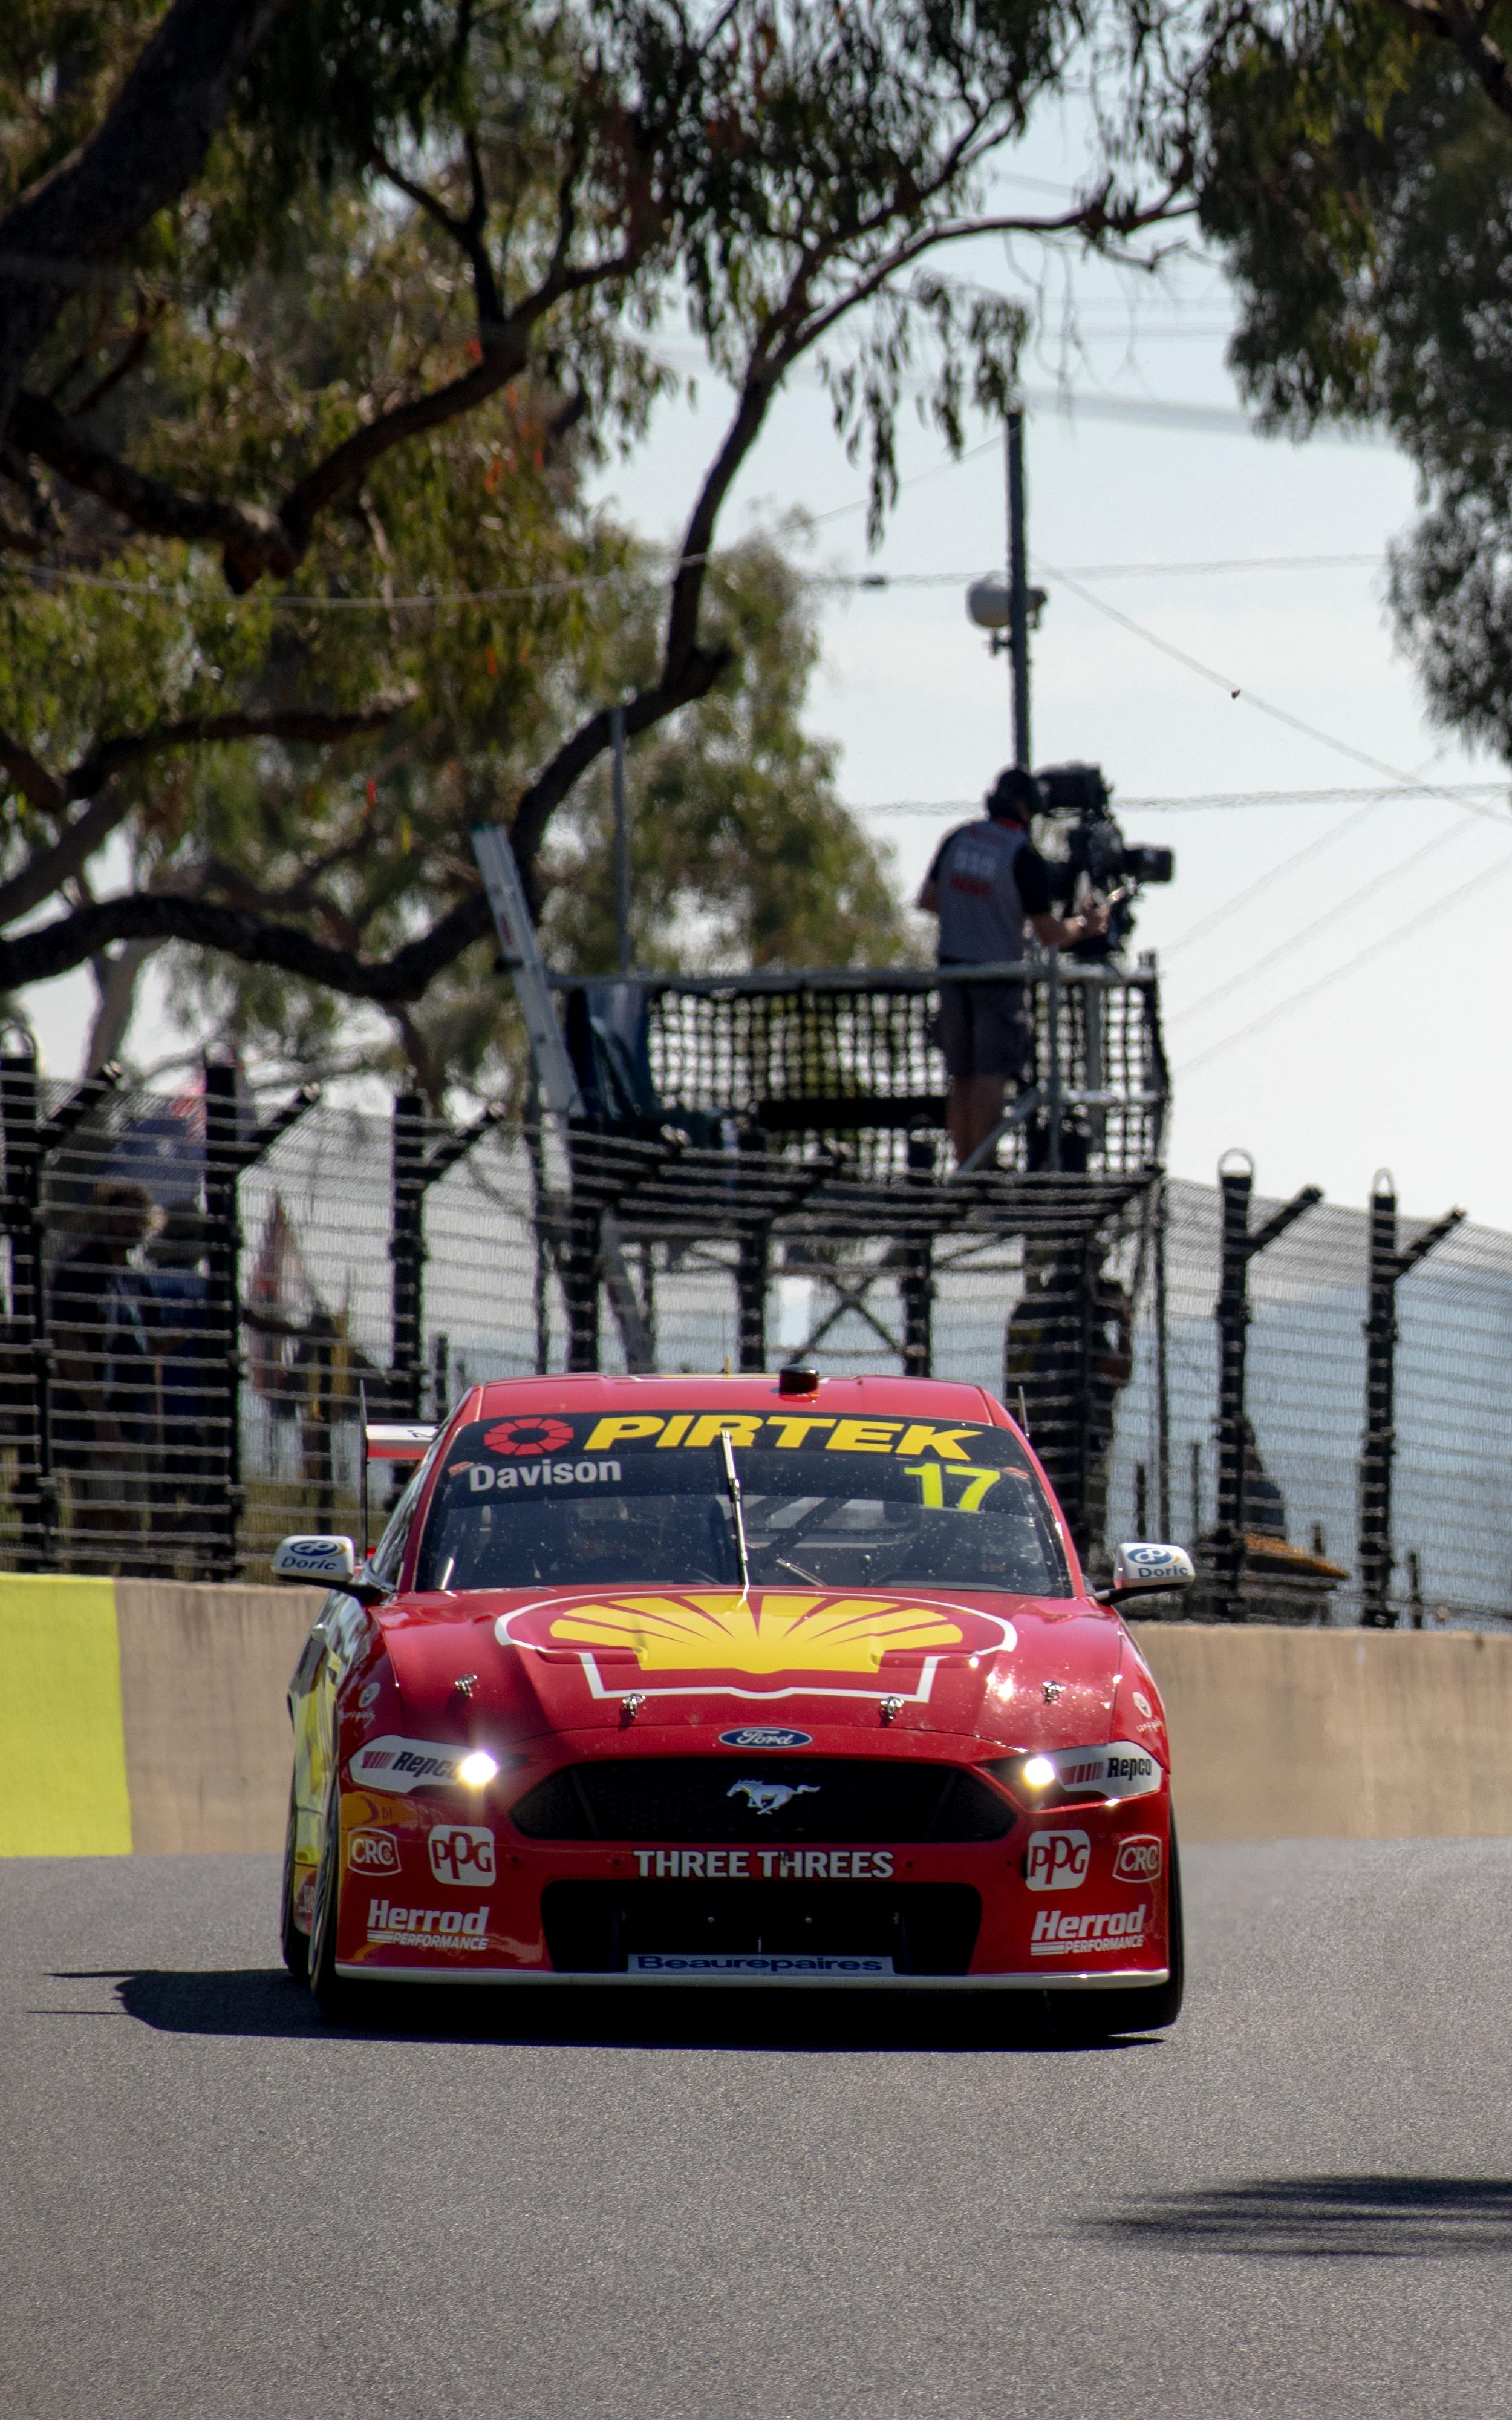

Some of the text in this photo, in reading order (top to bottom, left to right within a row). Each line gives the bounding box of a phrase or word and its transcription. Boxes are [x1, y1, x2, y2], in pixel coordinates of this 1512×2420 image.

[584, 1414, 984, 1461] PIRTEK
[469, 1459, 621, 1492] Davison
[904, 1462, 1000, 1511] 17
[281, 1556, 336, 1570] Doric
[1138, 1566, 1188, 1577] Doric
[737, 1728, 794, 1745] Ford
[1107, 1757, 1152, 1781] Repco
[351, 1837, 394, 1866] CRC
[432, 1831, 492, 1880] PPG
[633, 1851, 894, 1879] THREE THREES
[1030, 1836, 1088, 1885] PPG
[1120, 1845, 1158, 1872] CRC
[367, 1899, 490, 1935] Herrod
[1031, 1904, 1147, 1940] Herrod
[394, 1932, 489, 1951] PERFORMANCE
[1064, 1935, 1145, 1954] PERFORMANCE
[637, 1955, 883, 1972] Beaurepaires
